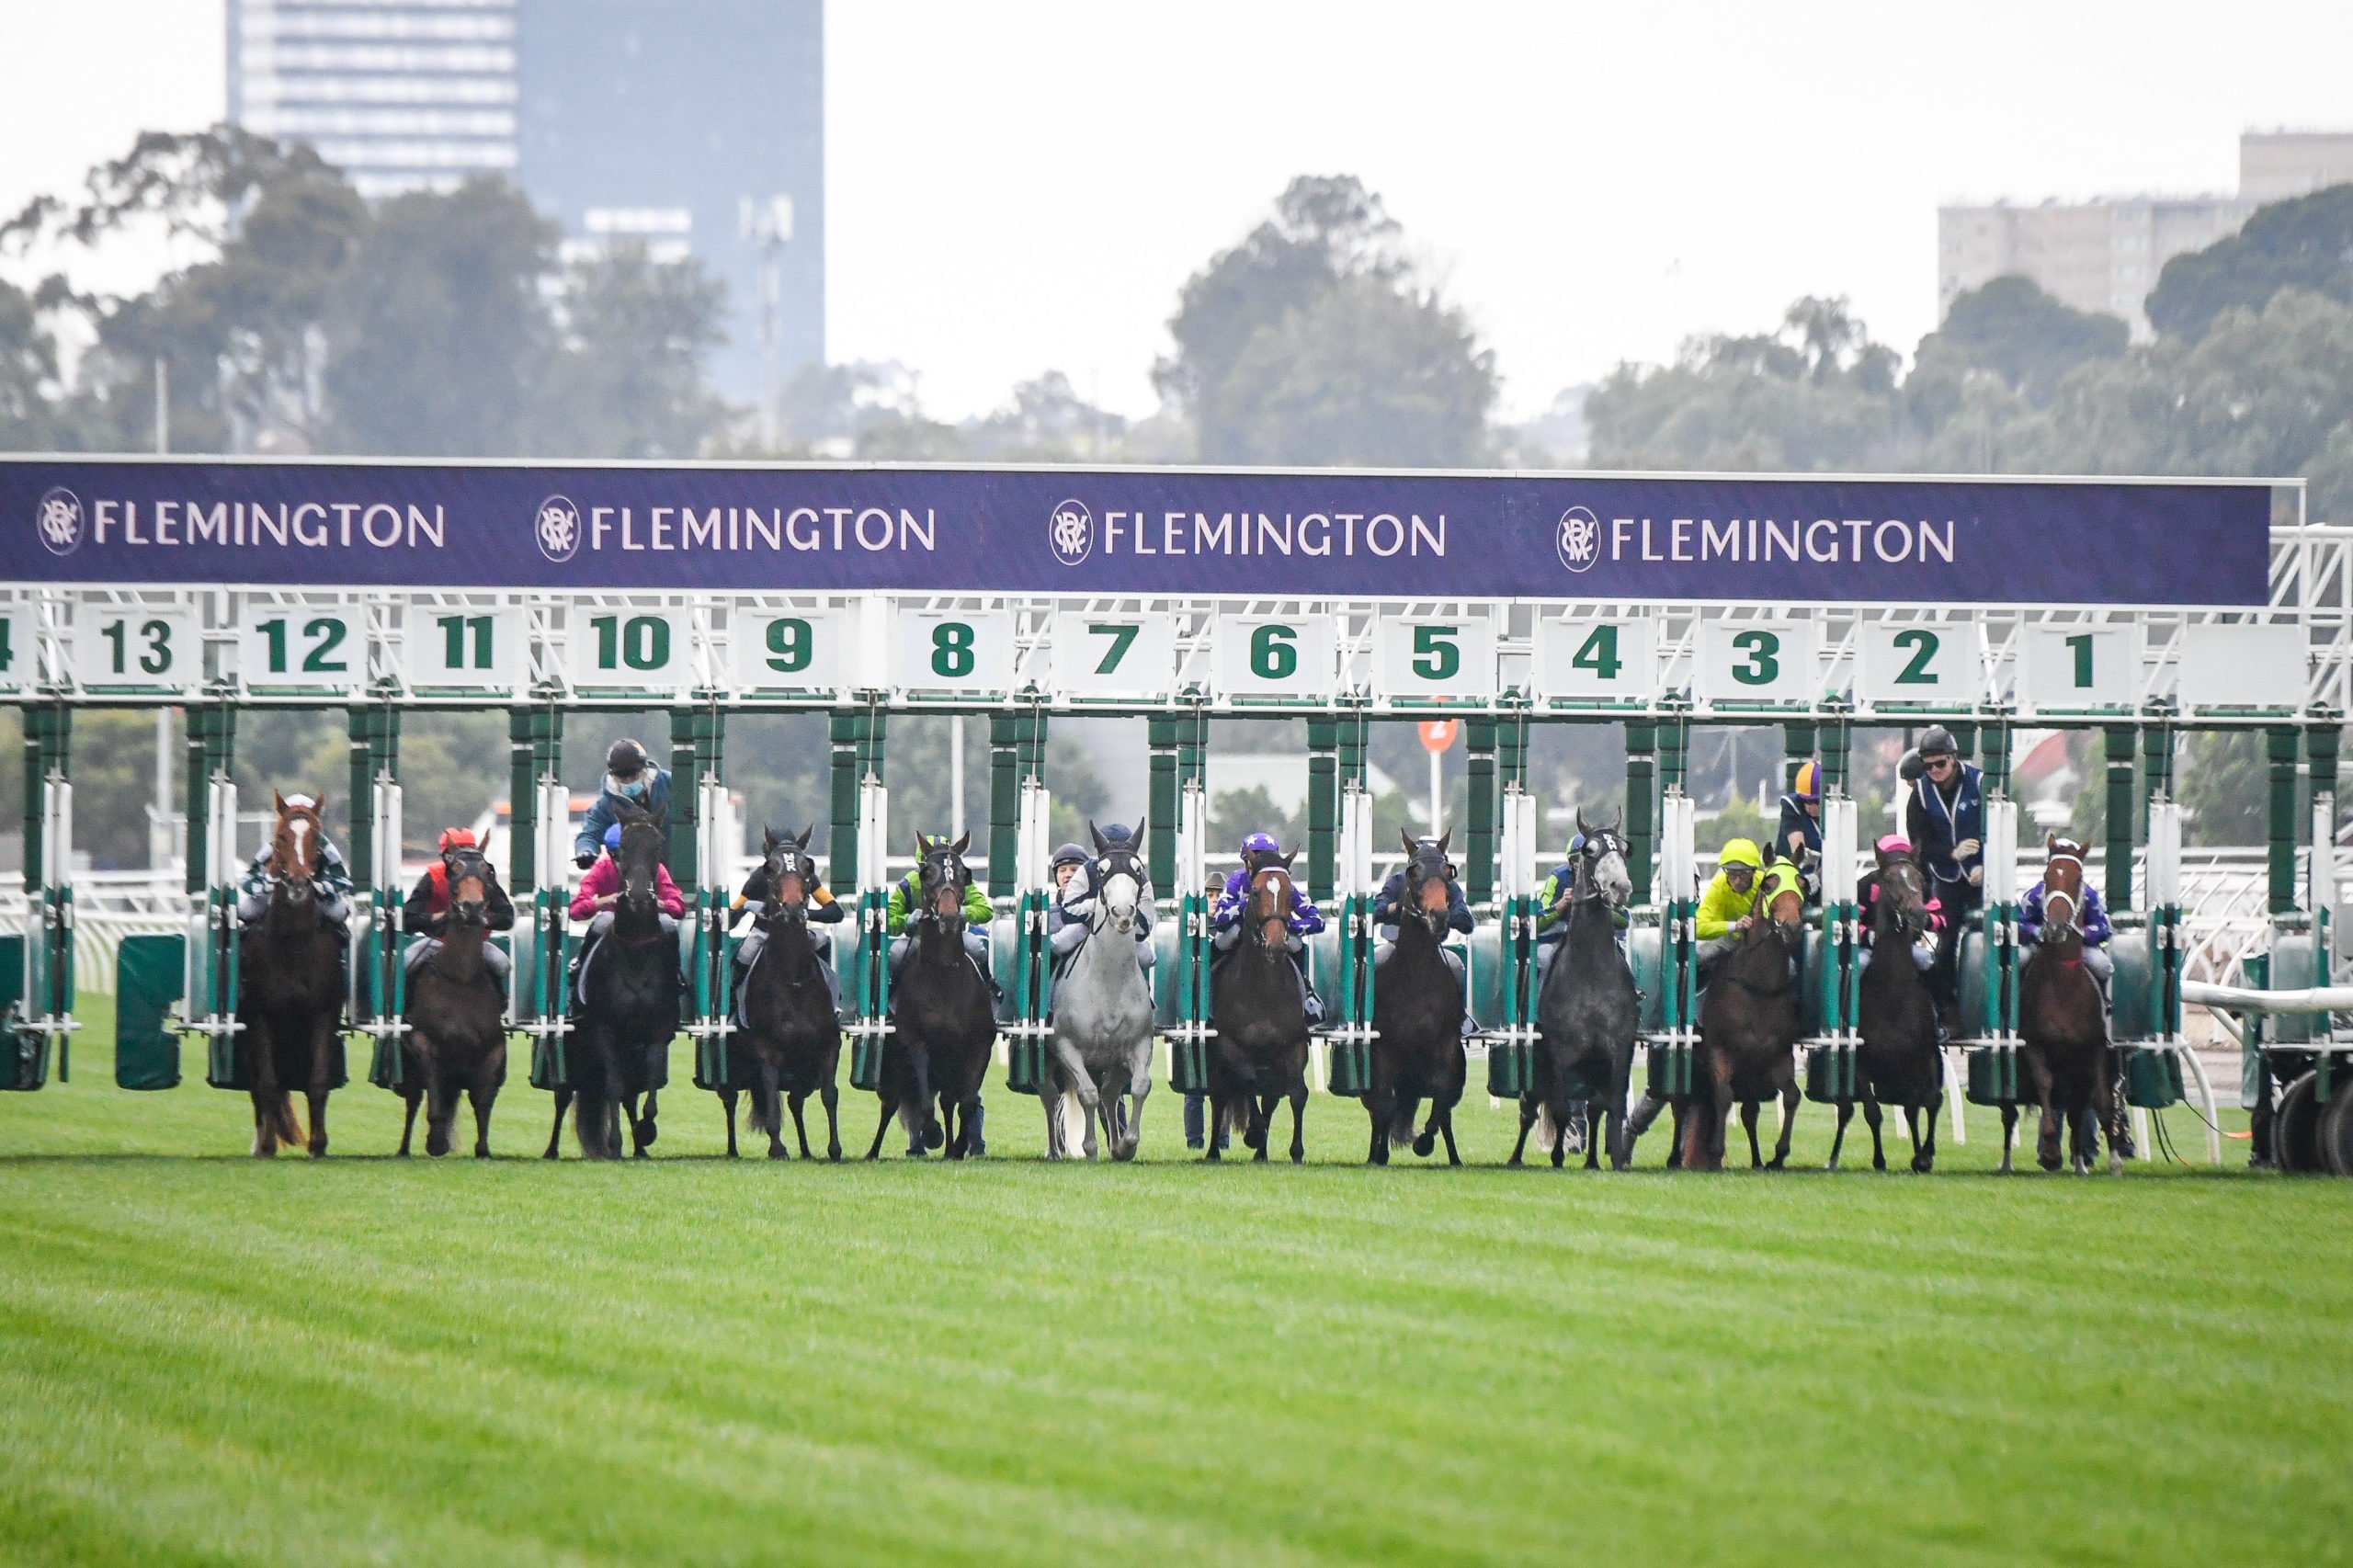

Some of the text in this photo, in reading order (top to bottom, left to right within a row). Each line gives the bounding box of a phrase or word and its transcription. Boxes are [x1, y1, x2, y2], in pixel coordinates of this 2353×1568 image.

[96, 501, 443, 547] FLEMINGTON
[592, 507, 934, 551] FLEMINGTON
[1106, 512, 1445, 556] FLEMINGTON
[1612, 519, 1953, 562] FLEMINGTON
[103, 619, 172, 674] 13
[256, 619, 347, 673] 12
[437, 616, 493, 669] 11
[591, 616, 670, 670] 10
[767, 619, 813, 673] 9
[932, 623, 975, 677] 8
[1088, 625, 1140, 674] 7
[1251, 625, 1298, 679] 6
[1413, 626, 1460, 680] 5
[1573, 625, 1622, 679] 4
[1732, 631, 1780, 685] 3
[1894, 631, 1939, 684] 2
[2065, 634, 2093, 687] 1
